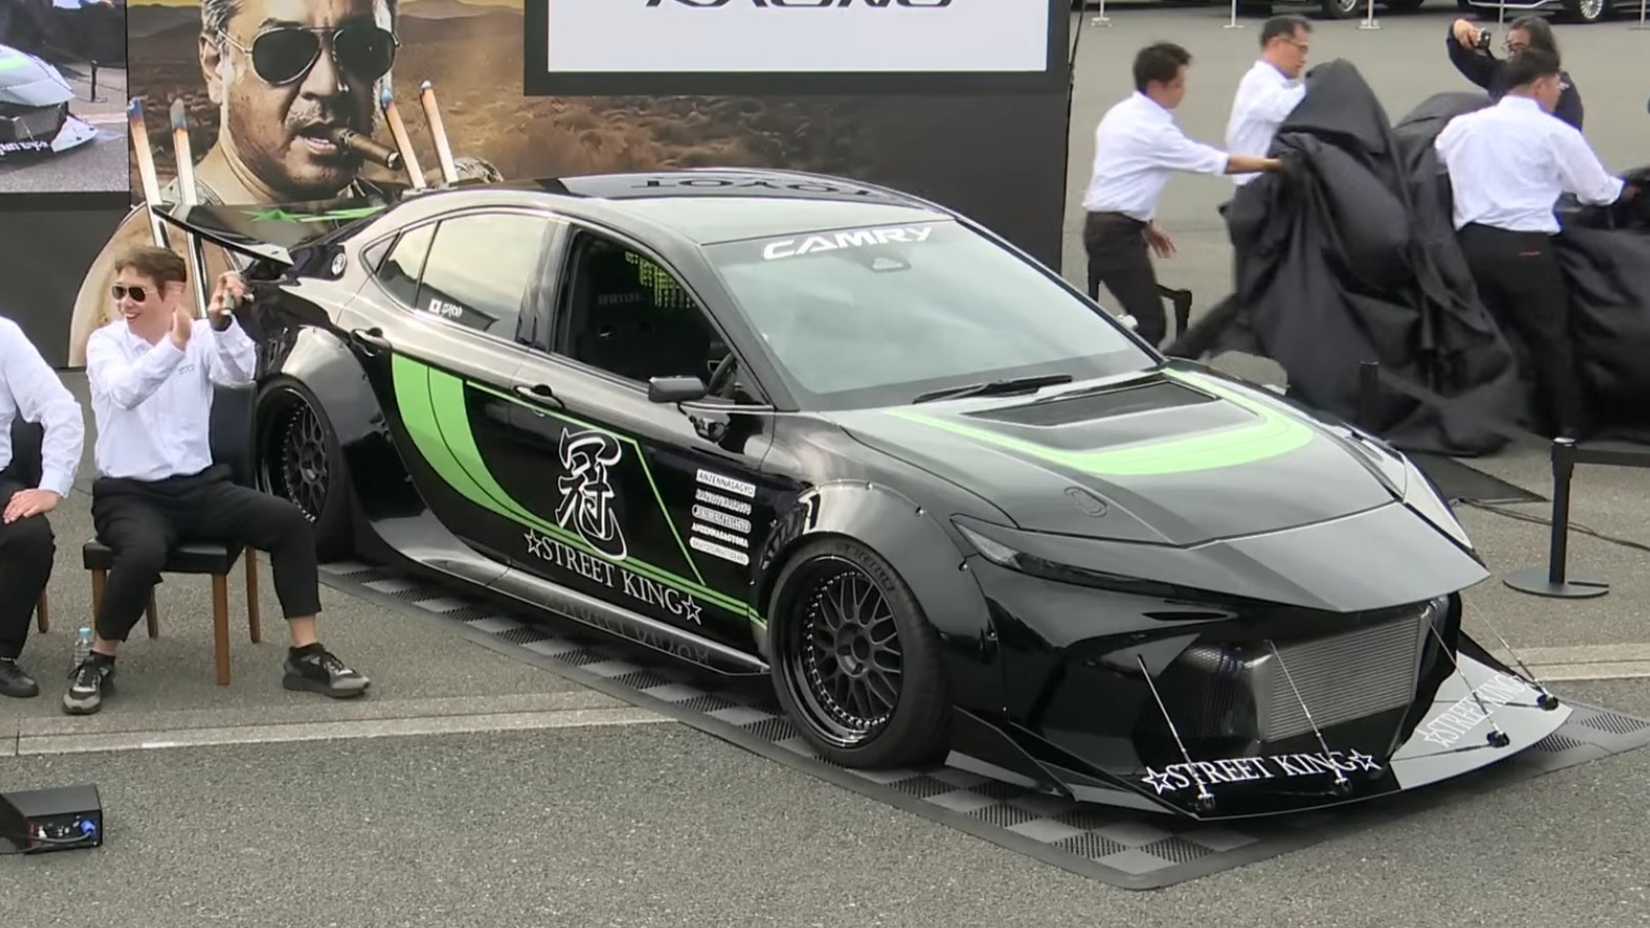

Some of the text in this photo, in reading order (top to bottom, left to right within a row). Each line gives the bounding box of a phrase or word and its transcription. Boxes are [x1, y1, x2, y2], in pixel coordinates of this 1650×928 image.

[763, 227, 932, 260] CAMRY
[555, 427, 627, 560] 冠
[542, 536, 683, 614] STREET KING
[1166, 751, 1358, 788] STREET KING
